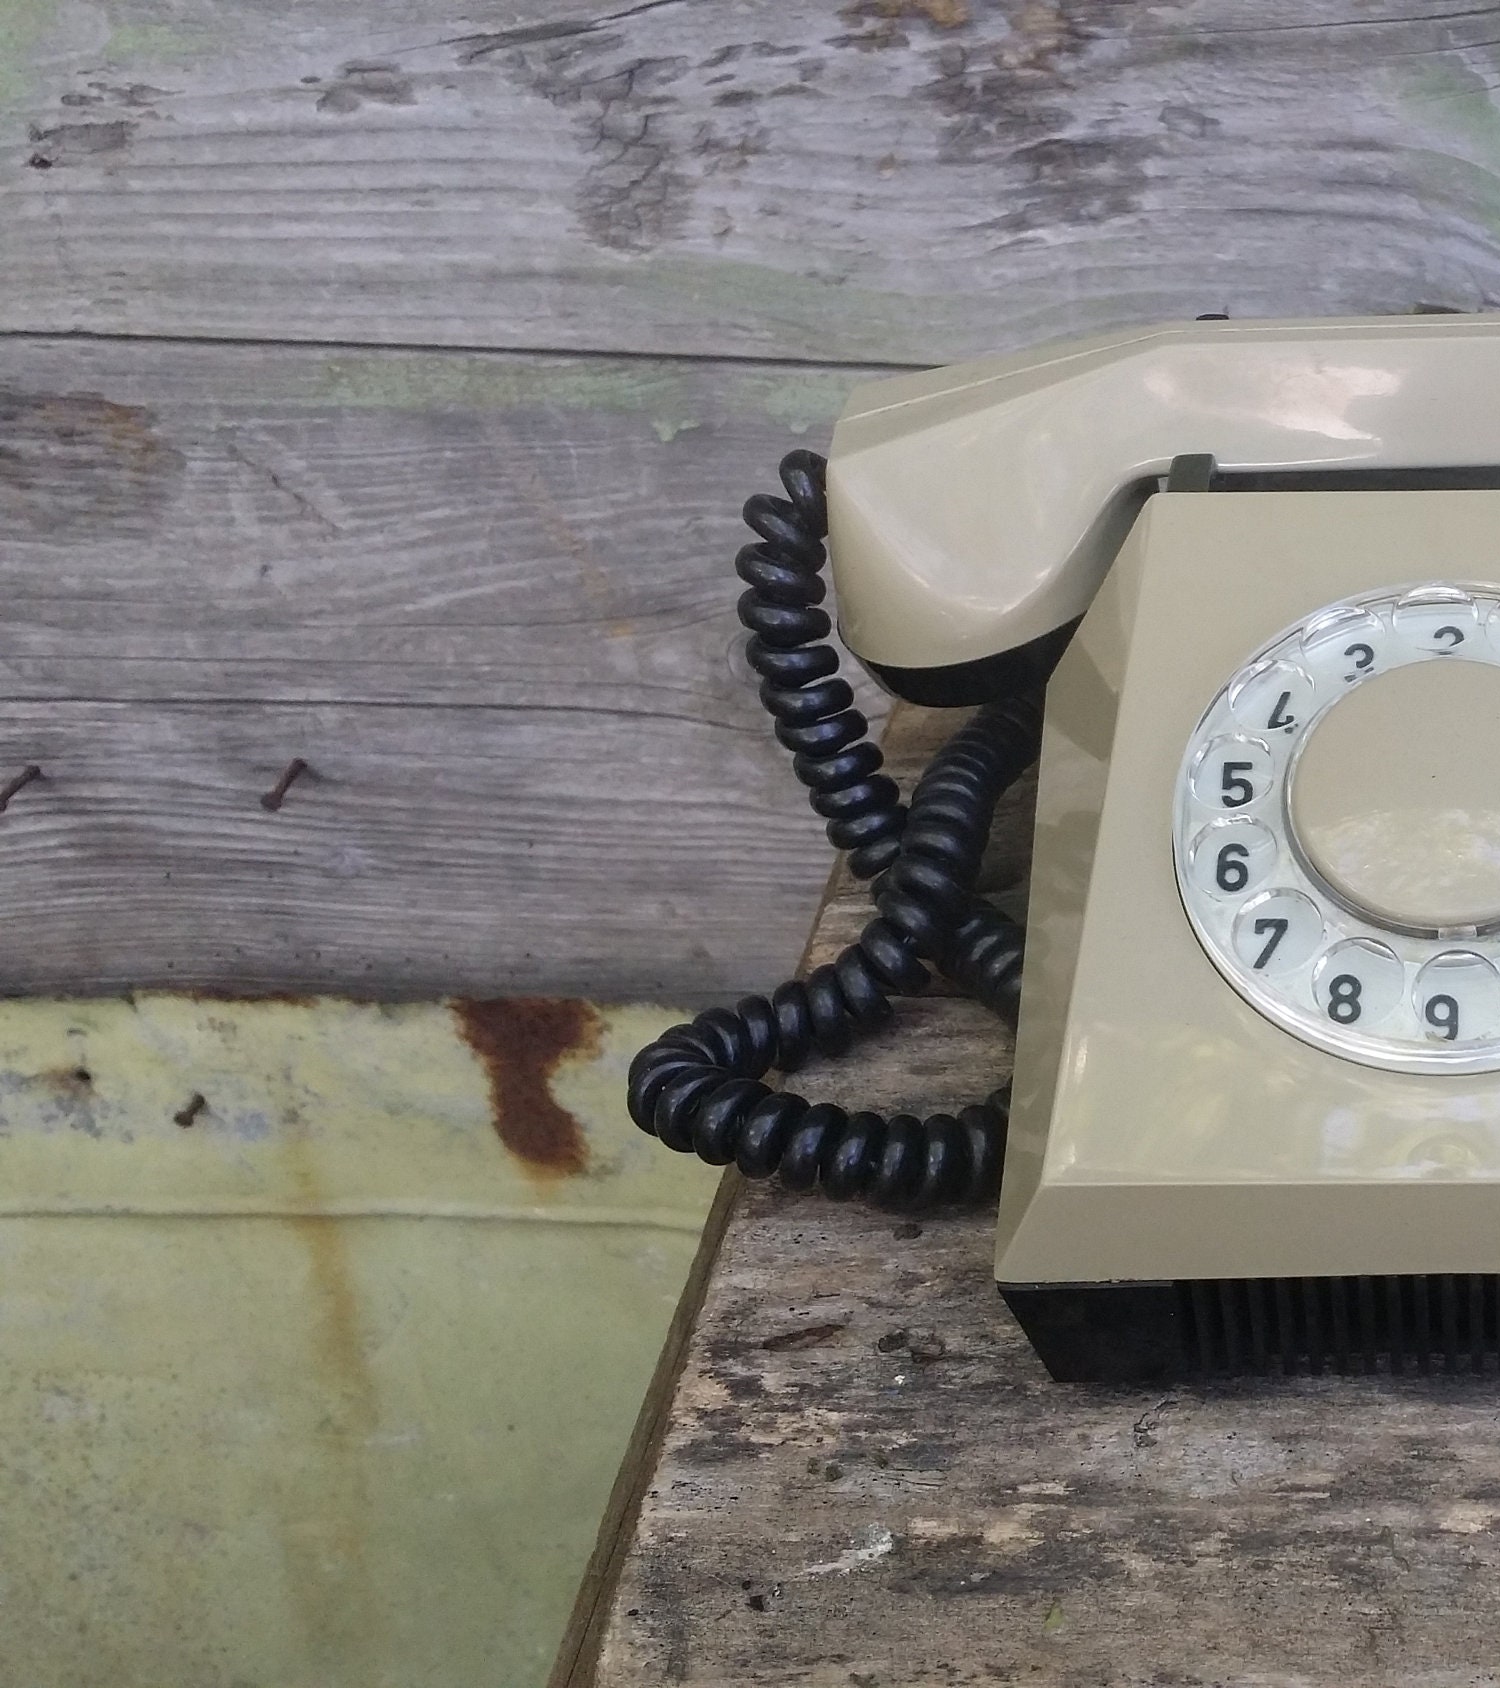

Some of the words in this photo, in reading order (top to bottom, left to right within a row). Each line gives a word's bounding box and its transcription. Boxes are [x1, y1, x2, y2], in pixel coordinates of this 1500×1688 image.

[1344, 643, 1376, 684] 3
[1433, 625, 1466, 656] 2
[1267, 691, 1299, 734] 4
[1221, 761, 1255, 808] 5
[1215, 843, 1250, 893] 6
[1253, 918, 1290, 970] 7
[1327, 974, 1363, 1026] 8
[1424, 994, 1460, 1041] 9
